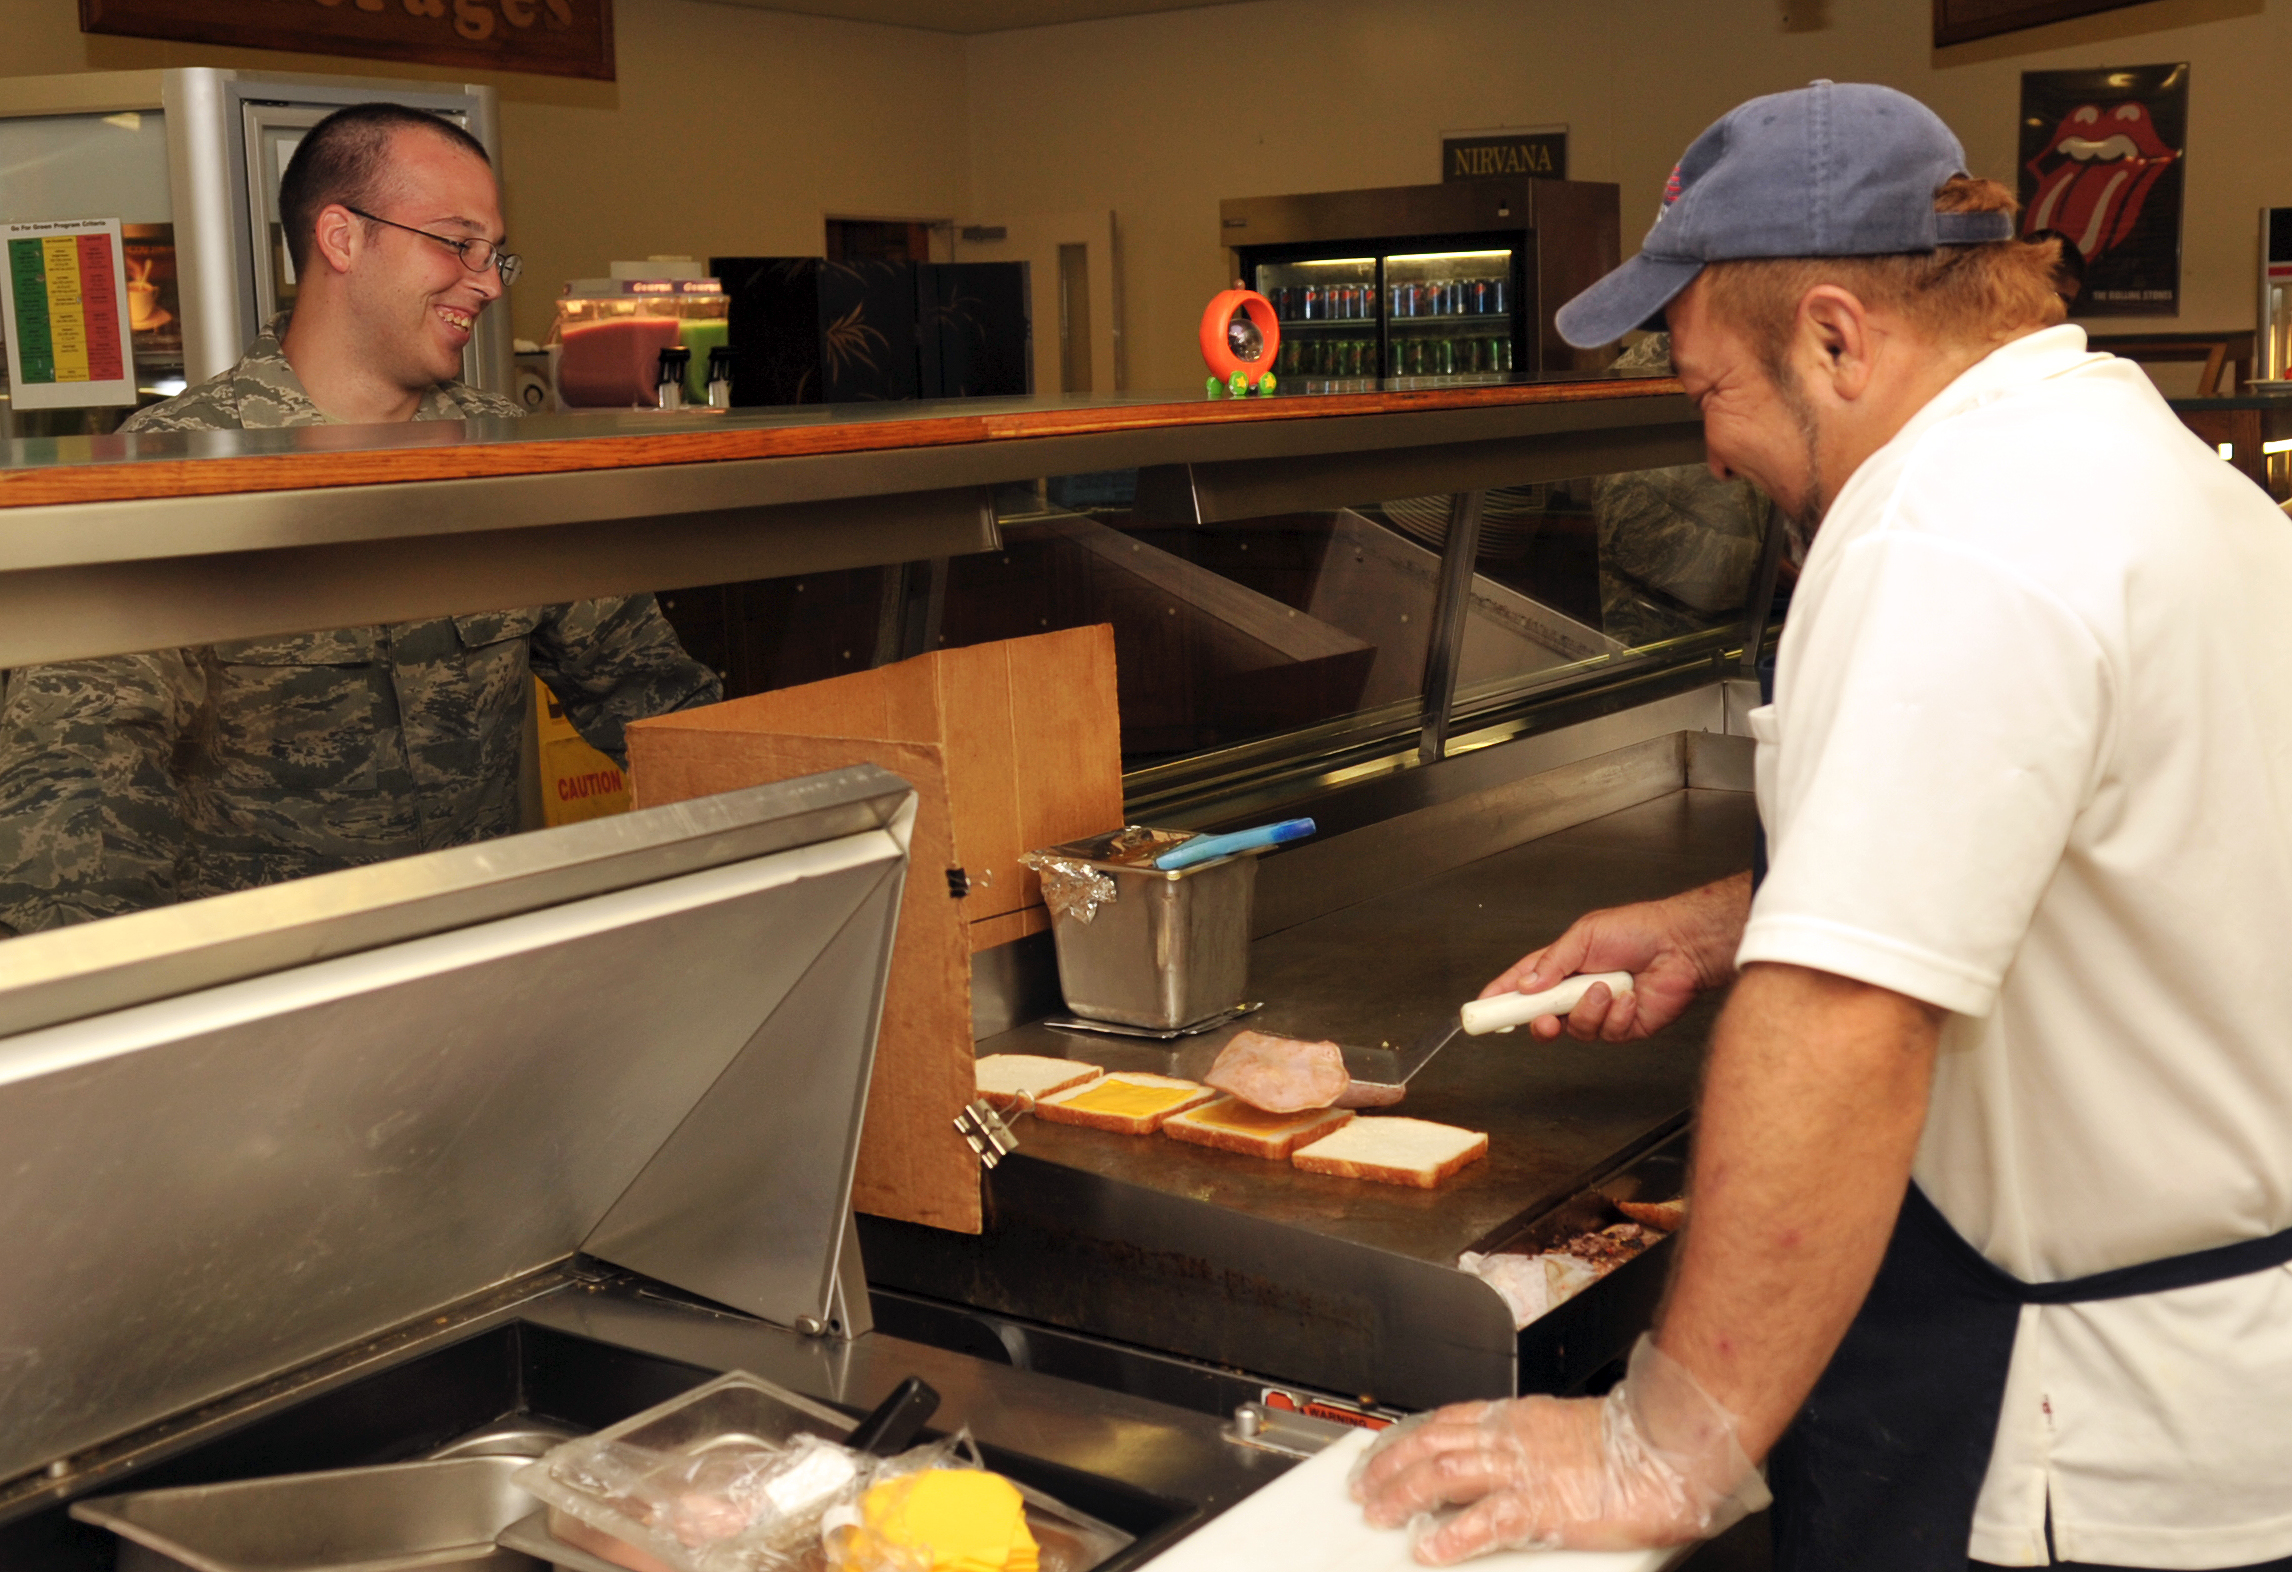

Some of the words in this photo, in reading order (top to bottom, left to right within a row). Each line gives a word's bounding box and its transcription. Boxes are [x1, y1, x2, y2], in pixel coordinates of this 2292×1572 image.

[1455, 144, 1552, 176] NIRVANA
[32, 223, 52, 231] Green
[2093, 290, 2107, 300] THE
[2108, 290, 2141, 300] ROLLING
[2142, 290, 2174, 300] STONES
[558, 769, 622, 801] CAUTION
